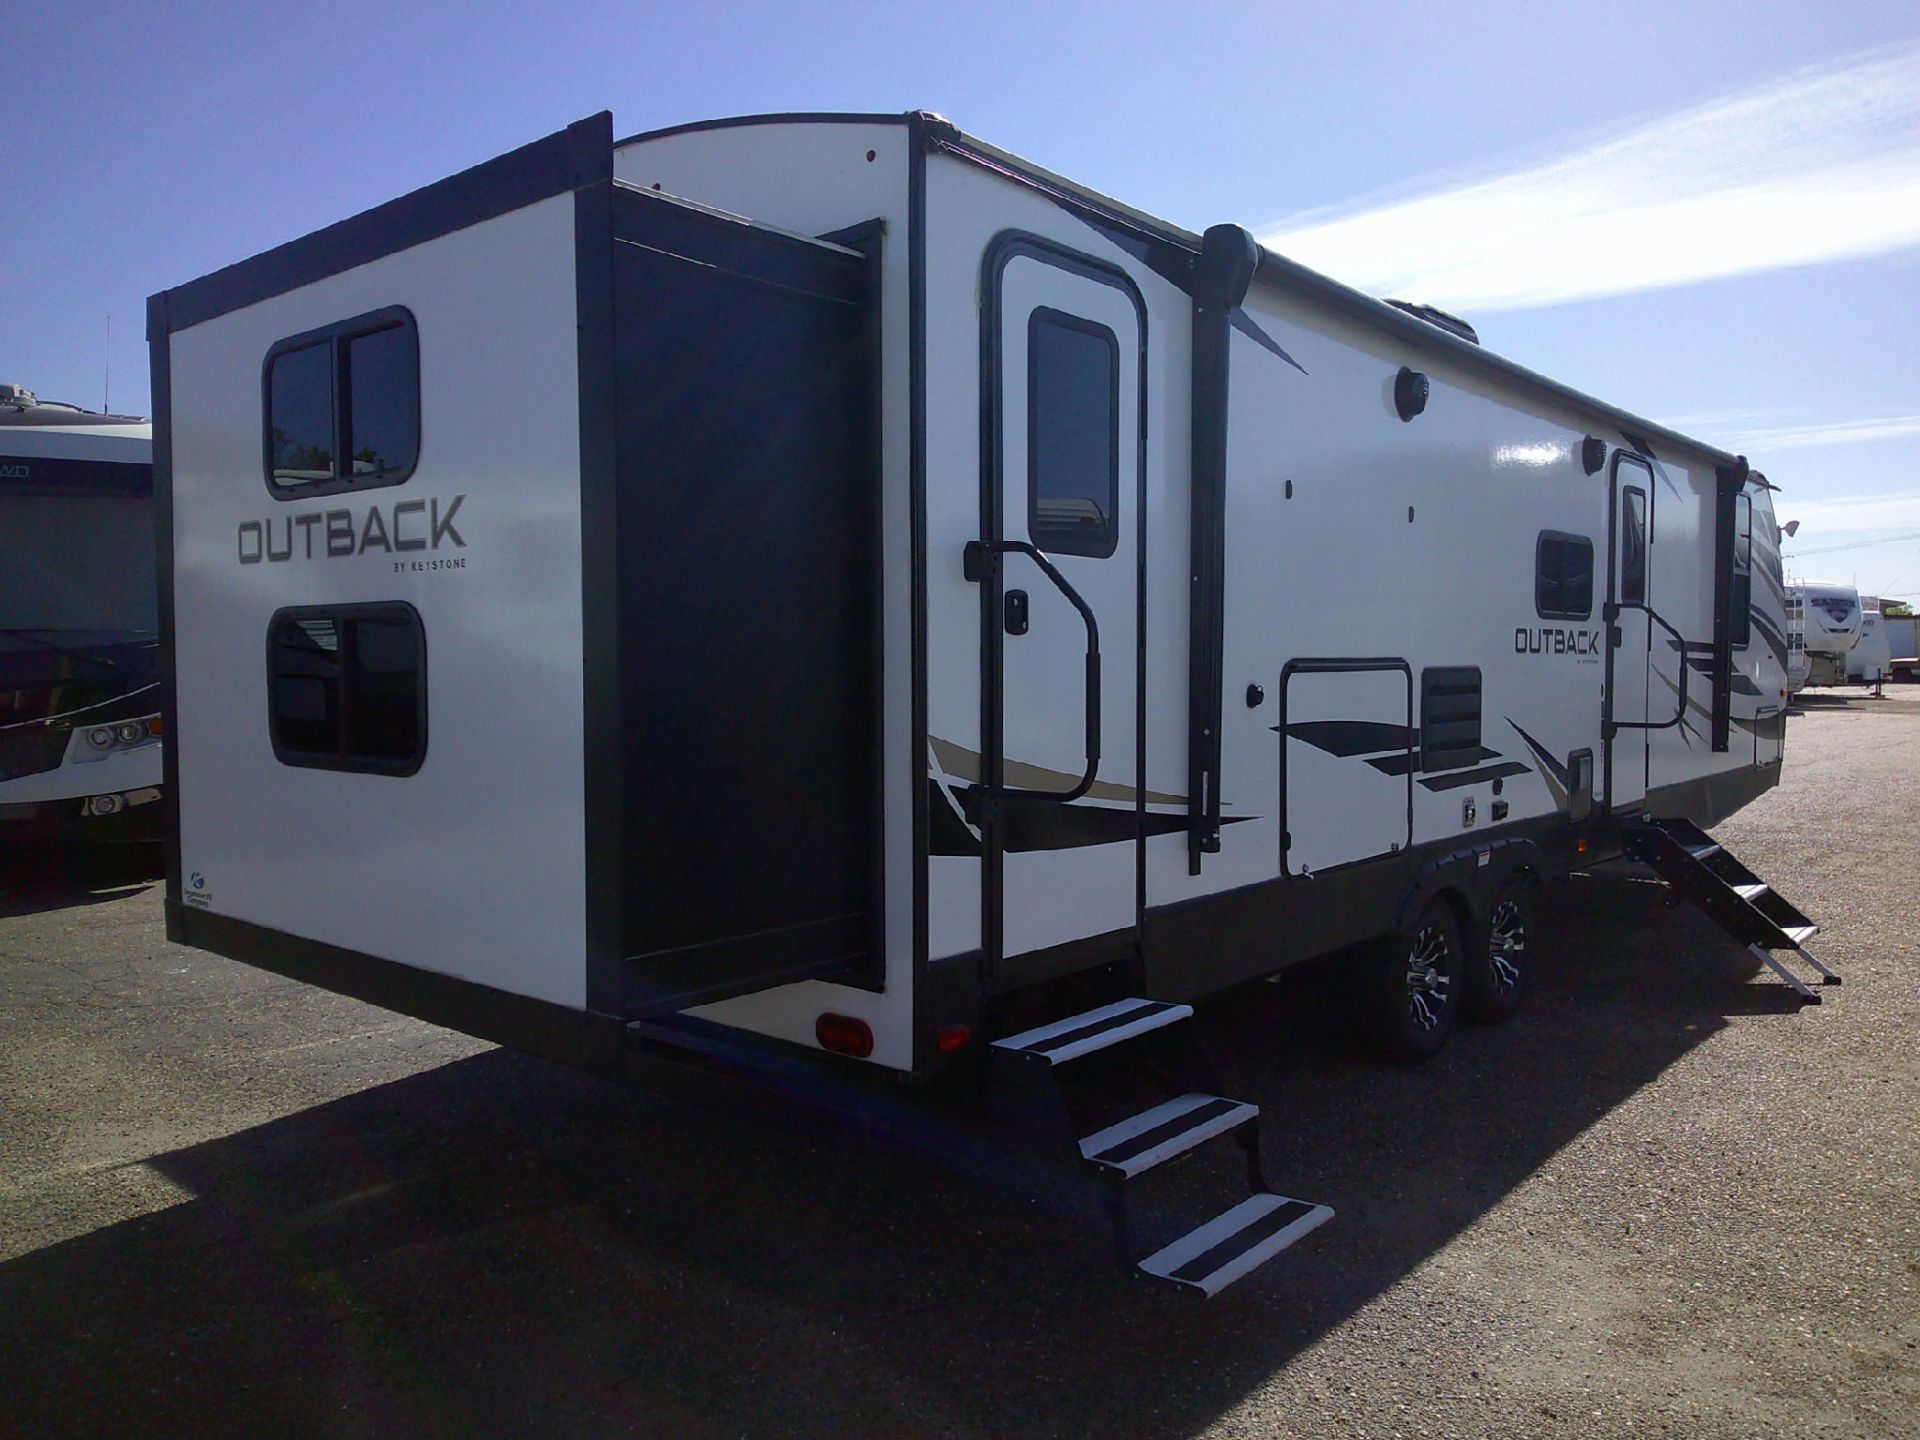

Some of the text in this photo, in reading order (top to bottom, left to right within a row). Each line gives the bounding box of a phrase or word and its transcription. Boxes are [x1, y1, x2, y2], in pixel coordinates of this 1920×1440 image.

[238, 494, 467, 565] OUTBACK
[394, 558, 467, 573] BY KEYSTONE
[1515, 627, 1599, 655] OUTBACK
